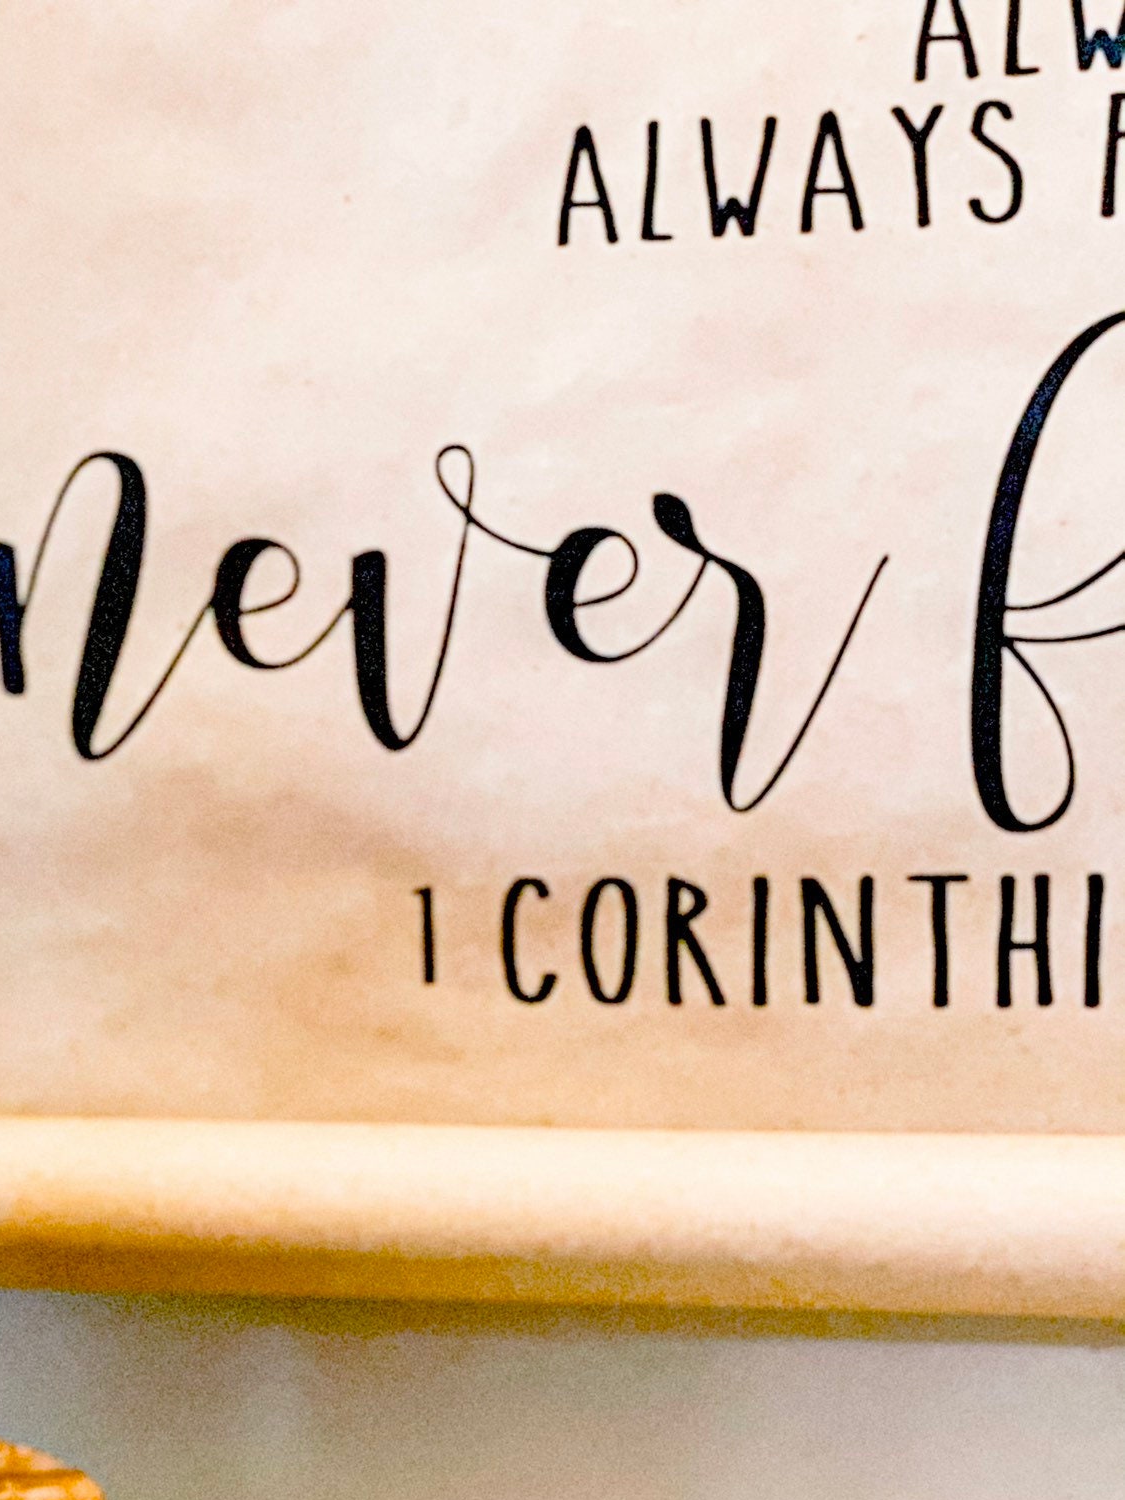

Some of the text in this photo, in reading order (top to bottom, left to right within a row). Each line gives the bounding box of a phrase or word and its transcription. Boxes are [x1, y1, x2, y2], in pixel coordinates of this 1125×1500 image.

[558, 100, 1024, 246] ALWAYS
[414, 873, 1106, 1009] 1 CORINTHI
